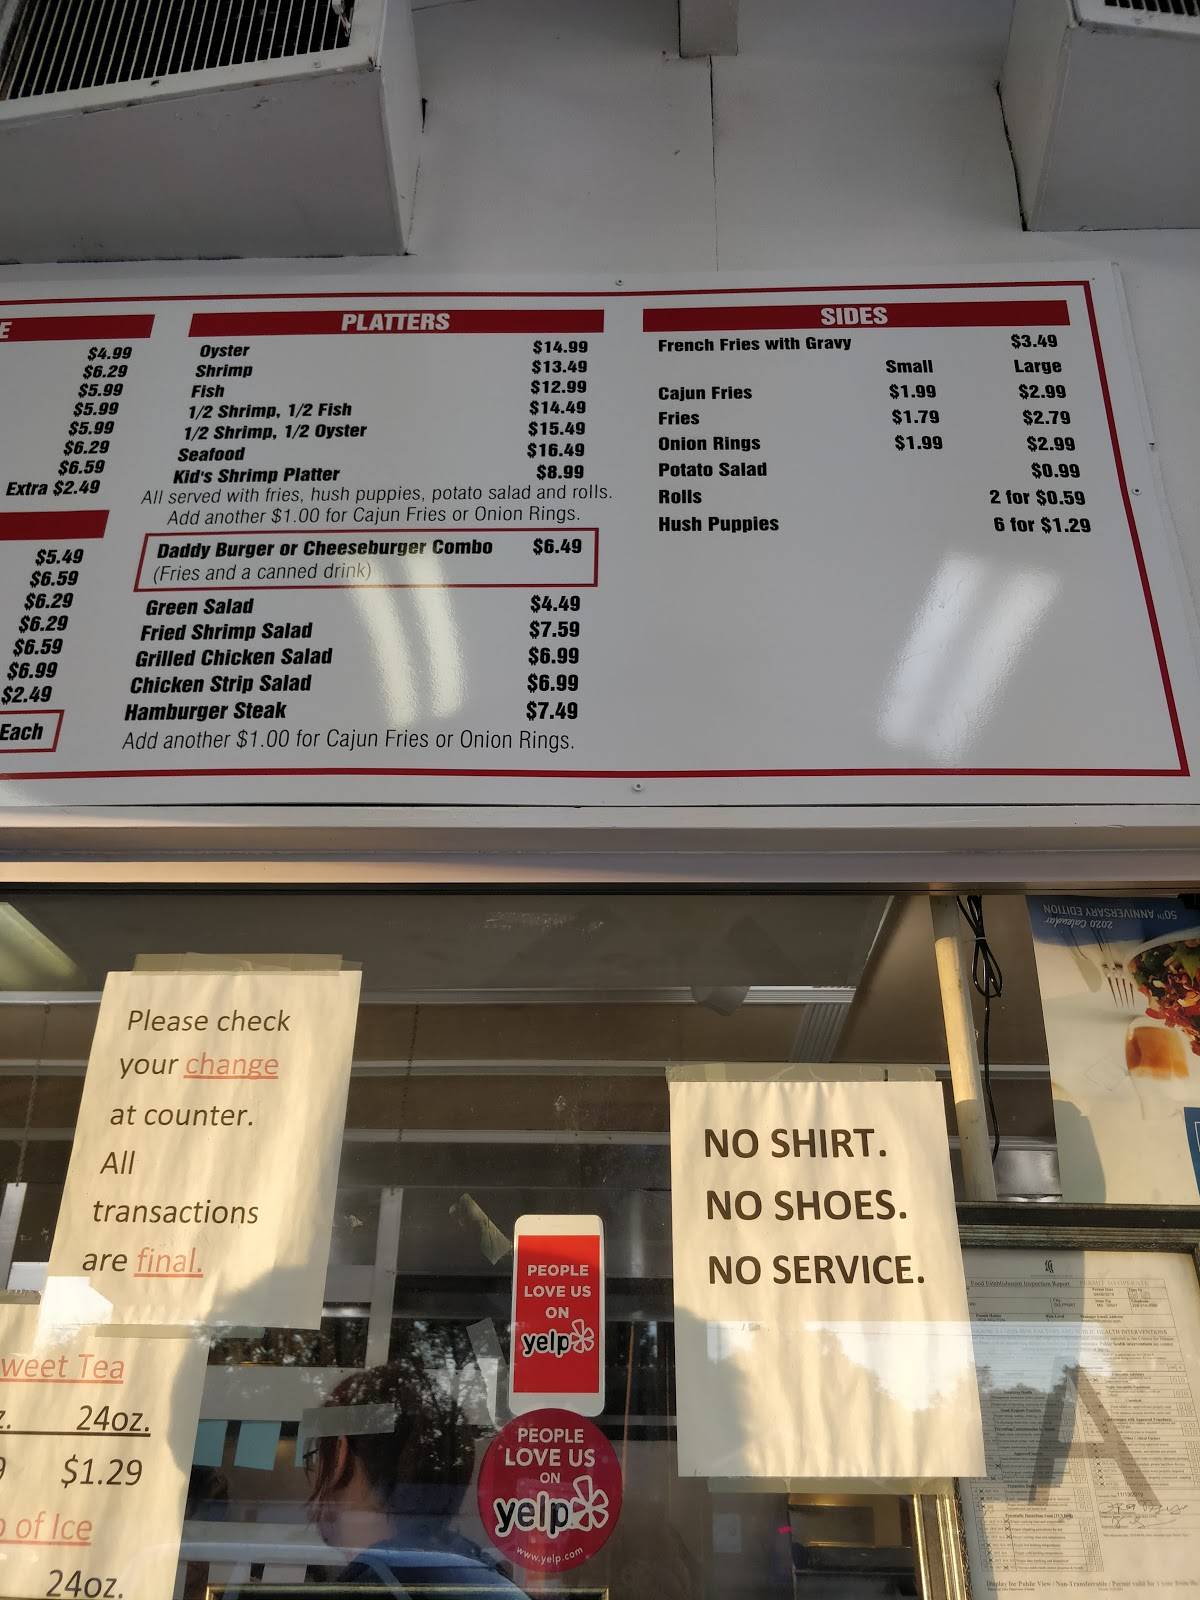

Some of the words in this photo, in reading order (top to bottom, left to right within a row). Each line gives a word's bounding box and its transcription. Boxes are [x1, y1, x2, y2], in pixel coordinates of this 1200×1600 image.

[341, 313, 450, 331] PLATTERS
[820, 307, 888, 325] SIDES
[200, 345, 250, 359] Oyster
[532, 340, 588, 355] $14.99
[658, 338, 714, 352] French
[720, 338, 760, 351] Fries
[765, 337, 800, 350] with
[805, 336, 852, 350] Gravy
[1010, 333, 1058, 349] $3.49
[195, 364, 253, 379] Shrimp
[531, 360, 588, 375] $13.49
[885, 359, 934, 374] Small
[1014, 359, 1062, 374] Large
[191, 384, 225, 398] Fish
[530, 380, 587, 395] $12.99
[658, 386, 706, 401] Cajun
[711, 386, 753, 400] Fries
[889, 383, 937, 400] $1.99
[1018, 383, 1067, 400] $2.99
[188, 405, 213, 419] 1/2
[217, 404, 281, 420] Shrimp,
[288, 403, 313, 418] 1/2
[318, 402, 352, 417] Fish
[529, 400, 586, 416] $14.49
[658, 411, 700, 425] Fries
[892, 409, 940, 425] $1.79
[1022, 409, 1071, 426] $2.79
[184, 427, 209, 441] 1/2
[213, 425, 278, 441] Shrimp,
[285, 424, 310, 440] 1/2
[315, 423, 367, 439] Oyster
[528, 421, 586, 437] $15.49
[177, 447, 246, 462] Seafood
[527, 442, 585, 458] $16.49
[658, 437, 707, 451] Onion
[713, 436, 761, 452] Rings
[894, 434, 943, 451] $1.99
[1026, 435, 1076, 452] $2.99
[173, 469, 212, 484] Kid's
[217, 468, 279, 484] Shrimp
[283, 467, 340, 482] Platter
[536, 464, 584, 481] $8.99
[658, 463, 714, 477] Potato
[718, 462, 767, 477] Salad
[1031, 462, 1081, 479] $0.99
[6, 482, 48, 496] Extra
[53, 480, 100, 497] $2.49
[141, 490, 163, 505] All
[168, 489, 227, 504] served
[229, 488, 260, 503] with
[265, 487, 304, 503] fries,
[311, 485, 350, 501] hush
[355, 485, 425, 504] puppies,
[432, 485, 482, 503] potato
[488, 484, 531, 500] salad
[536, 484, 566, 500] and
[572, 484, 613, 499] rolls.
[658, 489, 702, 504] Rolls
[989, 489, 1001, 505] 2
[1005, 489, 1030, 505] for
[1036, 489, 1086, 506] $0.59
[167, 510, 200, 525] Add
[205, 509, 267, 525] another
[271, 507, 320, 524] $1.00
[326, 507, 348, 523] for
[353, 507, 400, 525] Cajun
[406, 506, 446, 522] Fries
[452, 509, 469, 522] or
[474, 505, 523, 521] Onion
[529, 506, 581, 524] Rings.
[658, 516, 702, 532] Hush
[708, 516, 779, 533] Puppies
[993, 517, 1005, 532] 6
[1009, 517, 1035, 533] for
[1040, 516, 1092, 533] $1.29
[157, 543, 210, 560] Daddy
[215, 541, 275, 559] Burger
[279, 542, 298, 556] or
[303, 539, 426, 557] Cheeseburger
[432, 539, 493, 555] Combo
[532, 538, 582, 556] $6.49
[153, 565, 200, 585] (Fries
[205, 565, 236, 581] and
[241, 568, 251, 580] a
[257, 564, 318, 580] canned
[324, 562, 372, 581] drink)
[145, 600, 198, 616] Green
[203, 598, 254, 615] Salad
[530, 595, 581, 613] $4.49
[140, 625, 186, 641] Fried
[191, 623, 256, 642] Shrimp
[261, 622, 313, 639] Salad
[529, 621, 581, 639] $7.59
[135, 650, 195, 667] Grilled
[201, 649, 275, 666] Chicken
[281, 648, 333, 664] Salad
[528, 647, 579, 666] $6.99
[130, 676, 205, 694] Chicken
[210, 676, 253, 694] Strip
[259, 675, 312, 692] Salad
[527, 673, 579, 693] $6.99
[124, 703, 228, 721] Hamburger
[233, 702, 287, 719] Steak
[526, 701, 578, 721] $7.49
[0, 723, 44, 740] Each
[1044, 903, 1083, 917] EDITION
[1086, 905, 1154, 920] ANNIVERSARY
[1045, 917, 1087, 929] Calendar
[1090, 921, 1113, 929] 2020
[127, 1009, 209, 1032] Please
[217, 1009, 291, 1032] check
[119, 1057, 179, 1079] your
[185, 1052, 280, 1078] change
[110, 1104, 136, 1126] at
[144, 1105, 253, 1127] counter.
[704, 1128, 759, 1158] NO
[770, 1128, 887, 1158] SHIRT.
[100, 1150, 136, 1175] All
[93, 1199, 259, 1225] transactions
[706, 1190, 762, 1221] NO
[774, 1189, 907, 1221] SHOES.
[82, 1251, 128, 1272] are
[136, 1247, 204, 1273] final.
[708, 1255, 761, 1285] NO
[772, 1255, 925, 1285] SERVICE.
[527, 1264, 589, 1277] PEOPLE
[524, 1285, 565, 1297] LOVE
[570, 1285, 591, 1297] US
[545, 1307, 569, 1319] ON
[522, 1330, 570, 1356] yelp
[0, 1356, 68, 1378] weet
[79, 1354, 125, 1379] Tea
[76, 1405, 150, 1432] 24oz.
[517, 1428, 584, 1443] PEOPLE
[505, 1448, 561, 1467] LOVE
[568, 1449, 596, 1468] US
[61, 1454, 143, 1488] $1.29
[540, 1472, 561, 1484] ON
[494, 1492, 570, 1537] yelp
[16, 1511, 46, 1539] of
[52, 1513, 92, 1541] Ice
[516, 1546, 583, 1565] www.yelp.com
[46, 1569, 124, 1600] 24oz.
